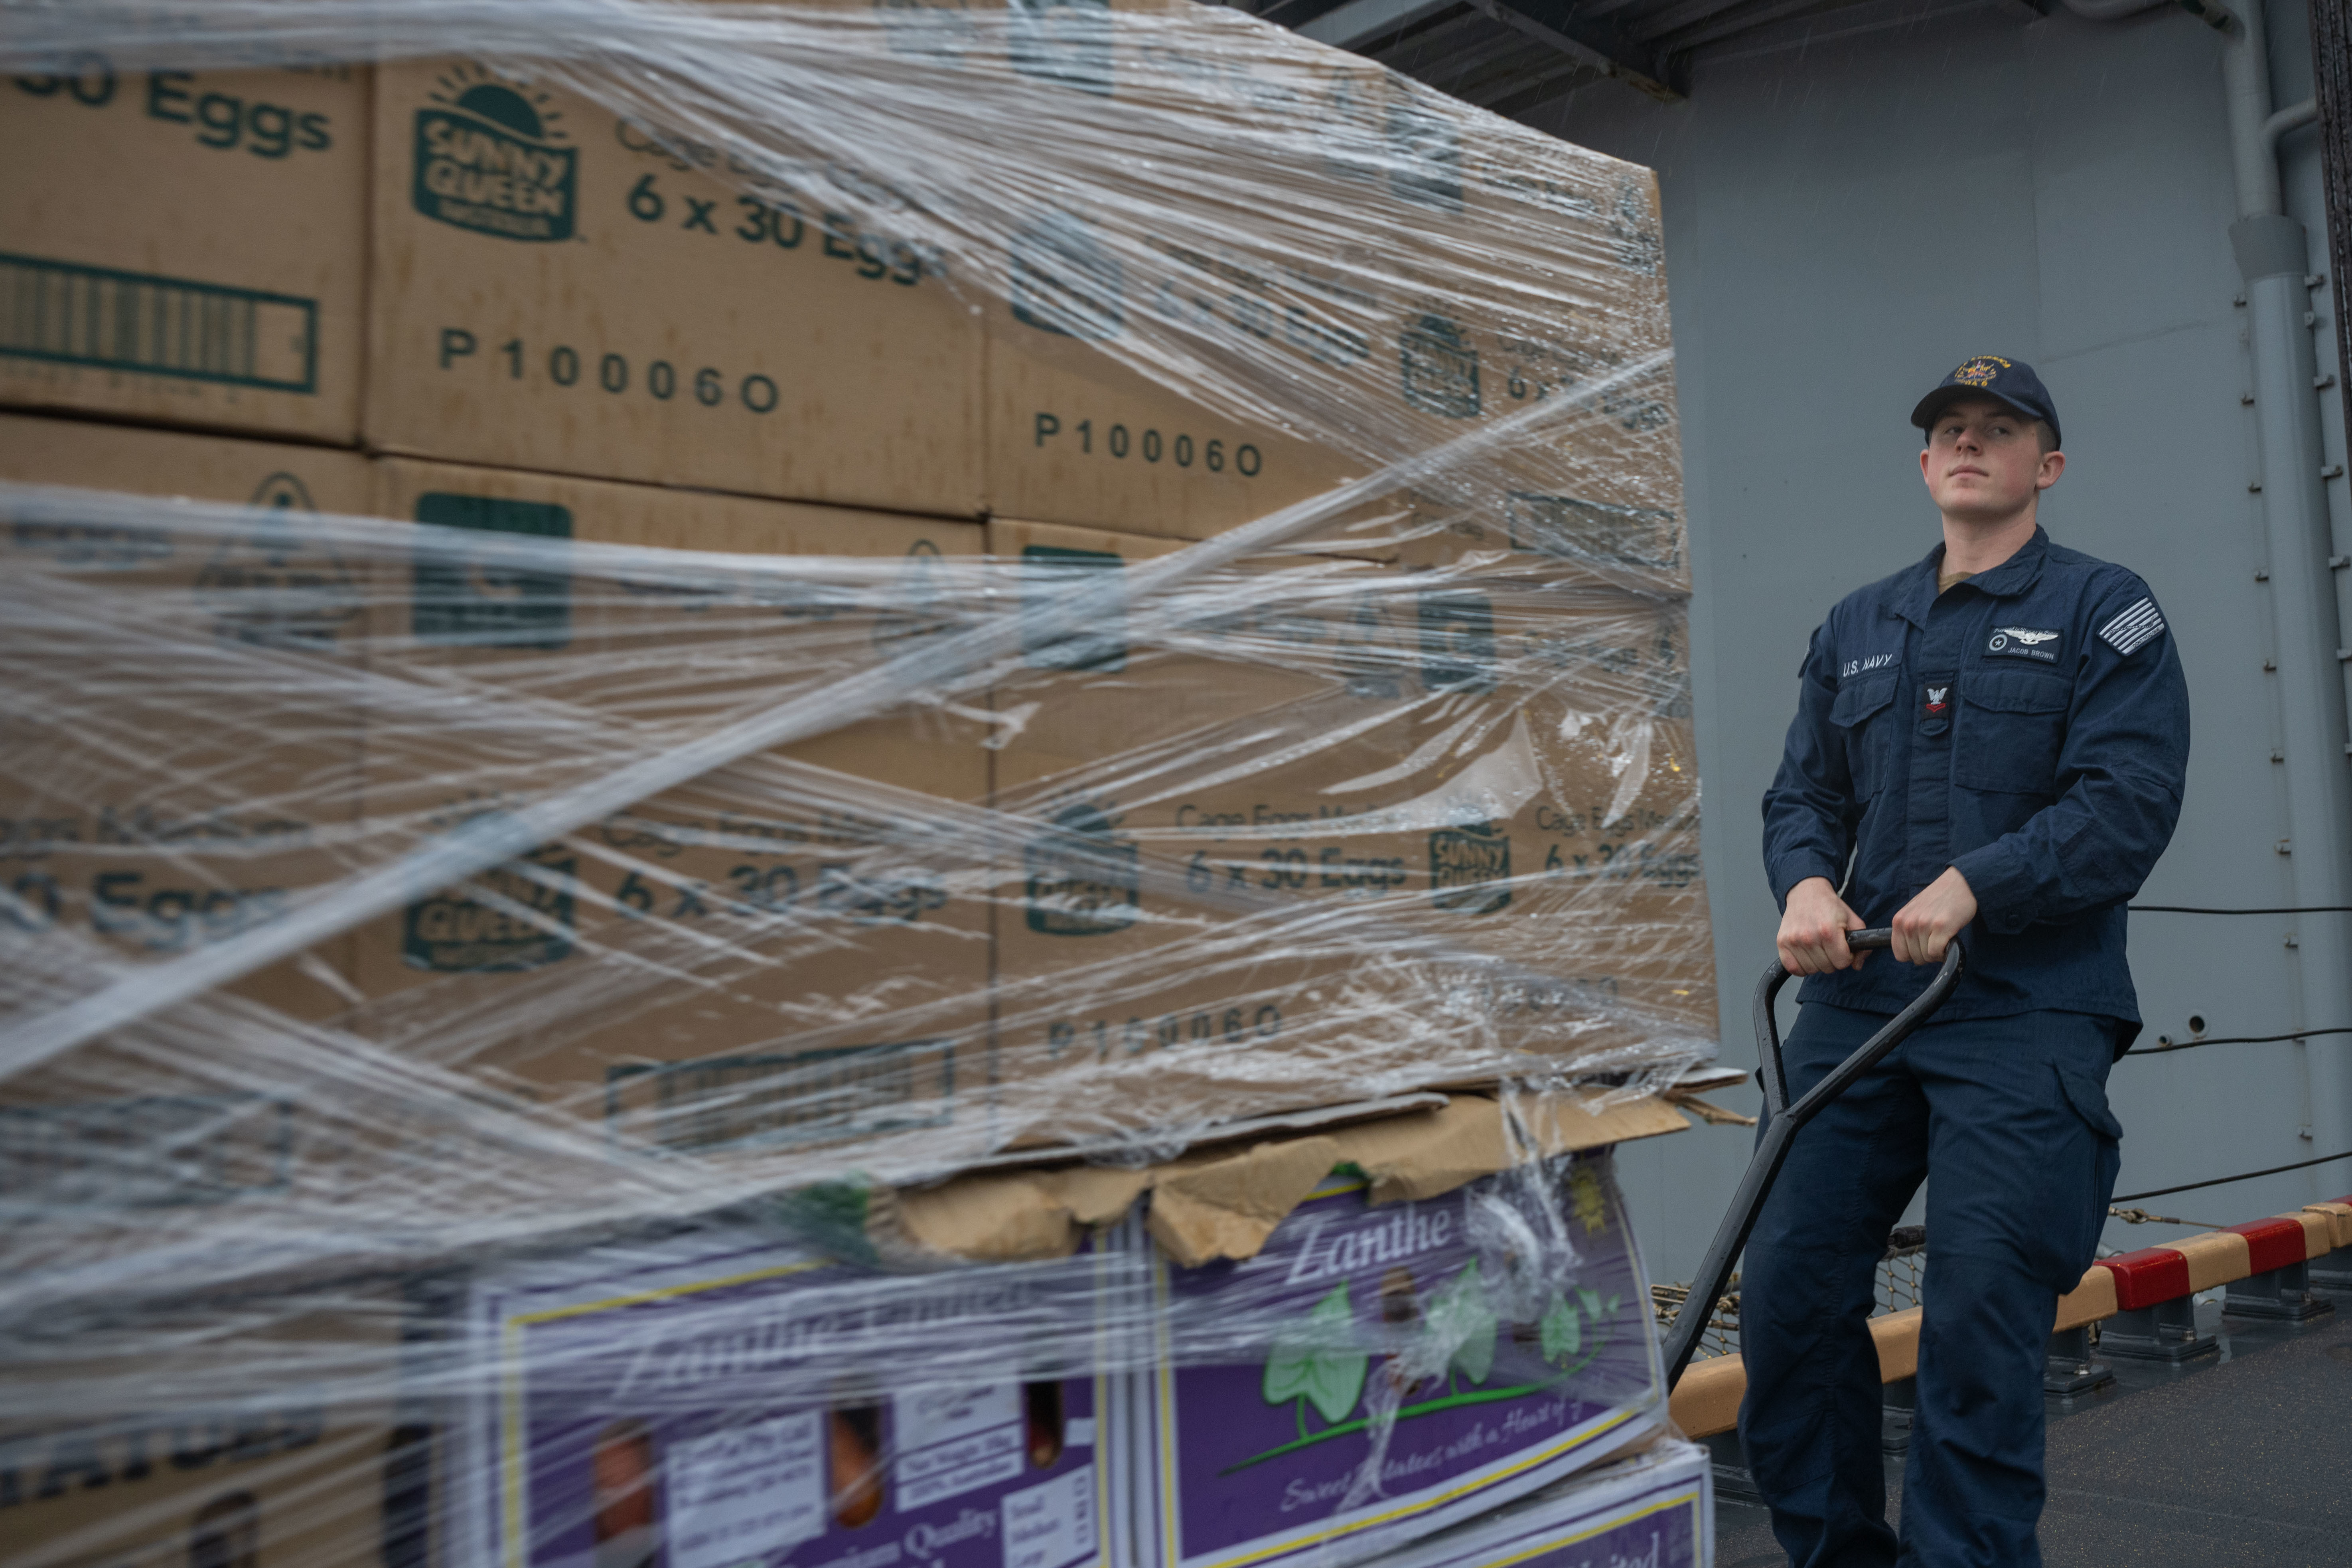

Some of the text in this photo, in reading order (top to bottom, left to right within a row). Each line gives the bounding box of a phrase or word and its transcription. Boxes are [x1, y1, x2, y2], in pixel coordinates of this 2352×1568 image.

[146, 67, 333, 160] Eggs
[626, 172, 665, 223] 6
[682, 194, 719, 235] x
[736, 193, 803, 249] 30
[1843, 653, 1892, 677] U.S. NAVY
[2031, 649, 2054, 660] BROWN
[1186, 850, 1212, 893] 6
[1260, 847, 1308, 889] 30
[1319, 846, 1407, 900] Eggs
[1435, 838, 1504, 870] SUNNY
[616, 870, 654, 920] 6
